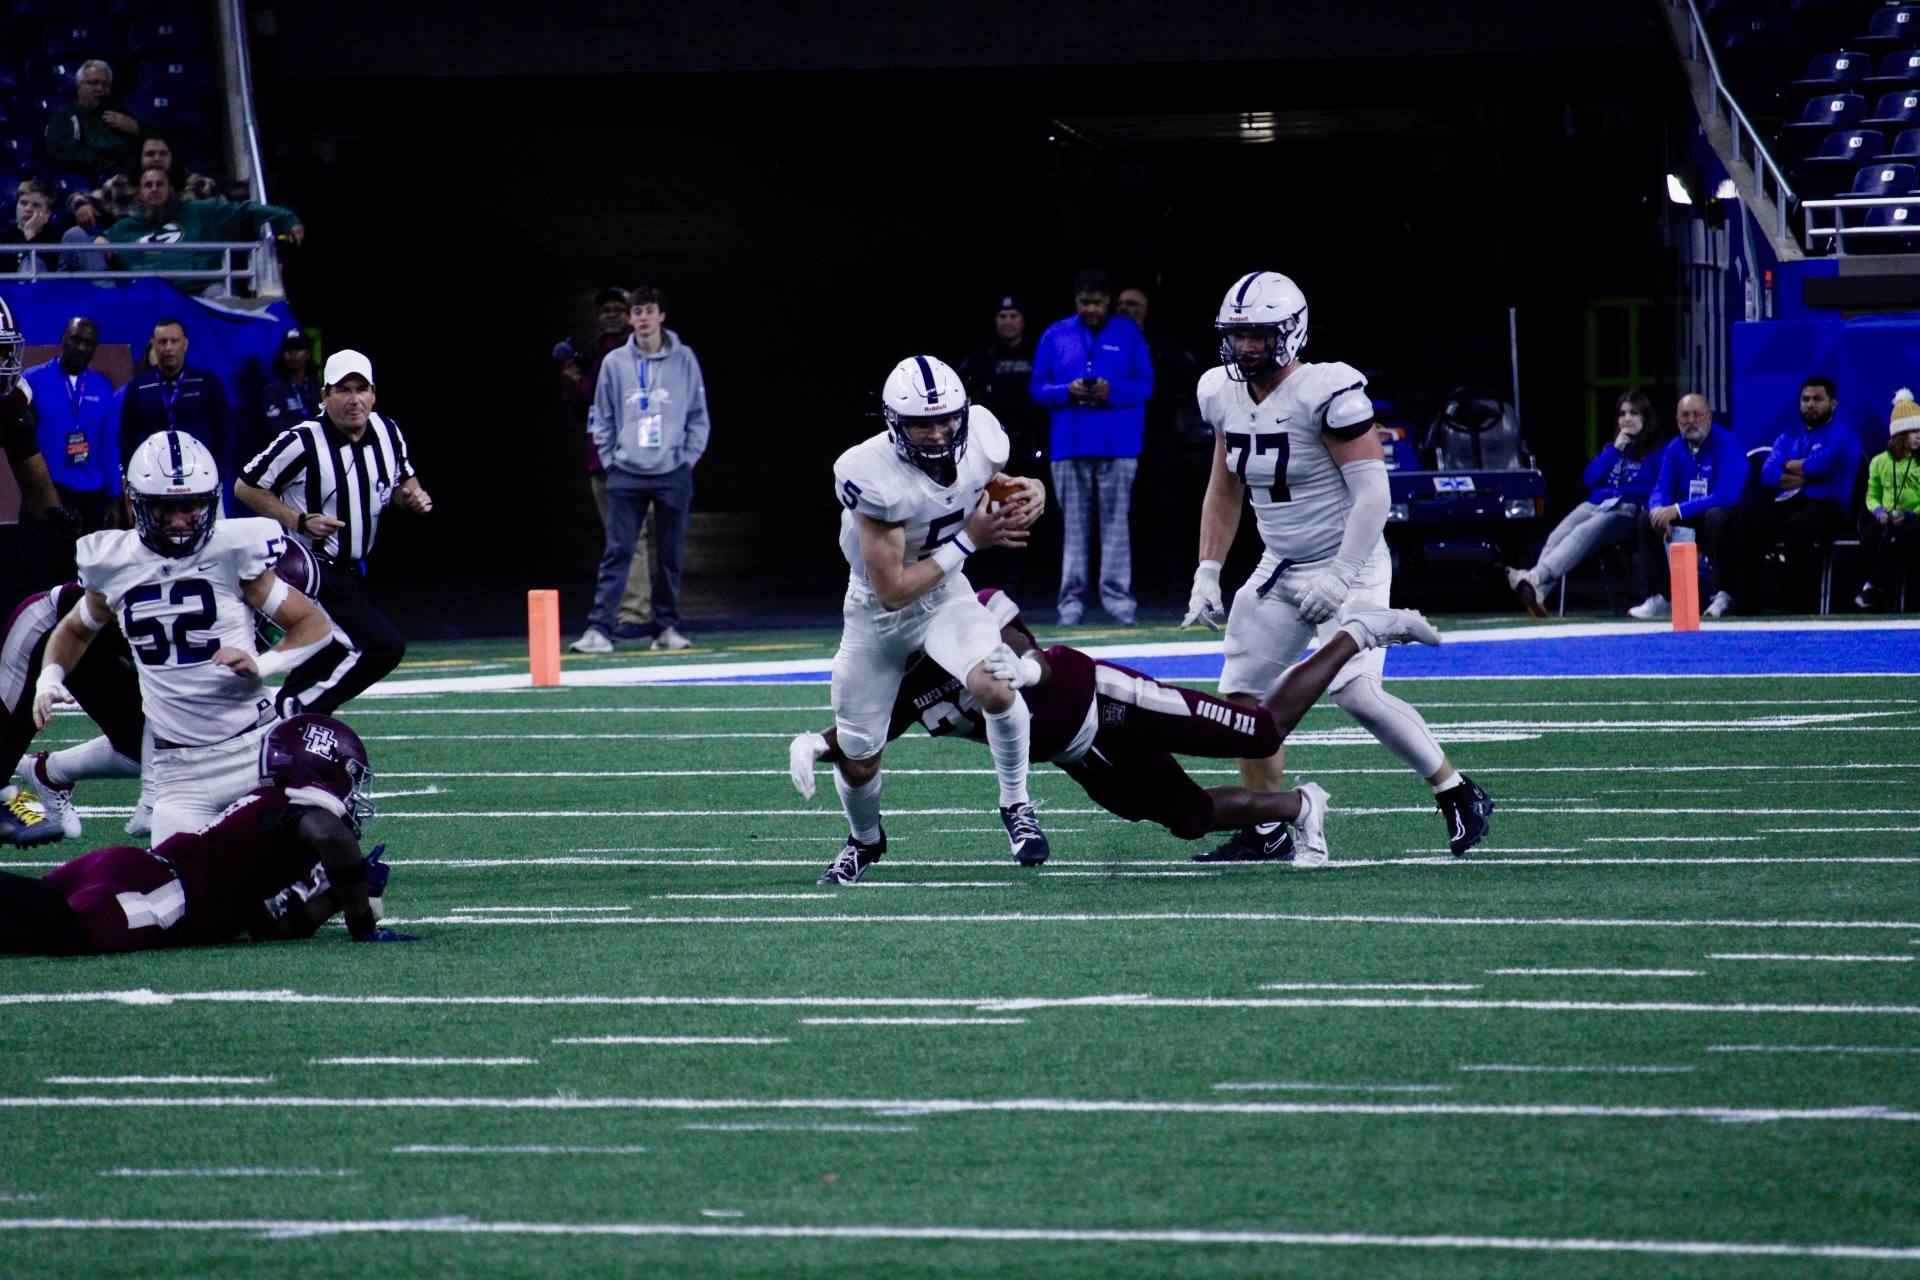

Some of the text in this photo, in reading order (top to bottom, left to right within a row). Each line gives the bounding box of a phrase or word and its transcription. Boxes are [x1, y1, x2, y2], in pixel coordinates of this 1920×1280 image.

[924, 404, 947, 412] Riddell
[1226, 432, 1292, 503] 77
[842, 479, 863, 510] 5
[124, 579, 220, 665] 52
[912, 687, 944, 709] HARPER
[303, 723, 338, 760] HW
